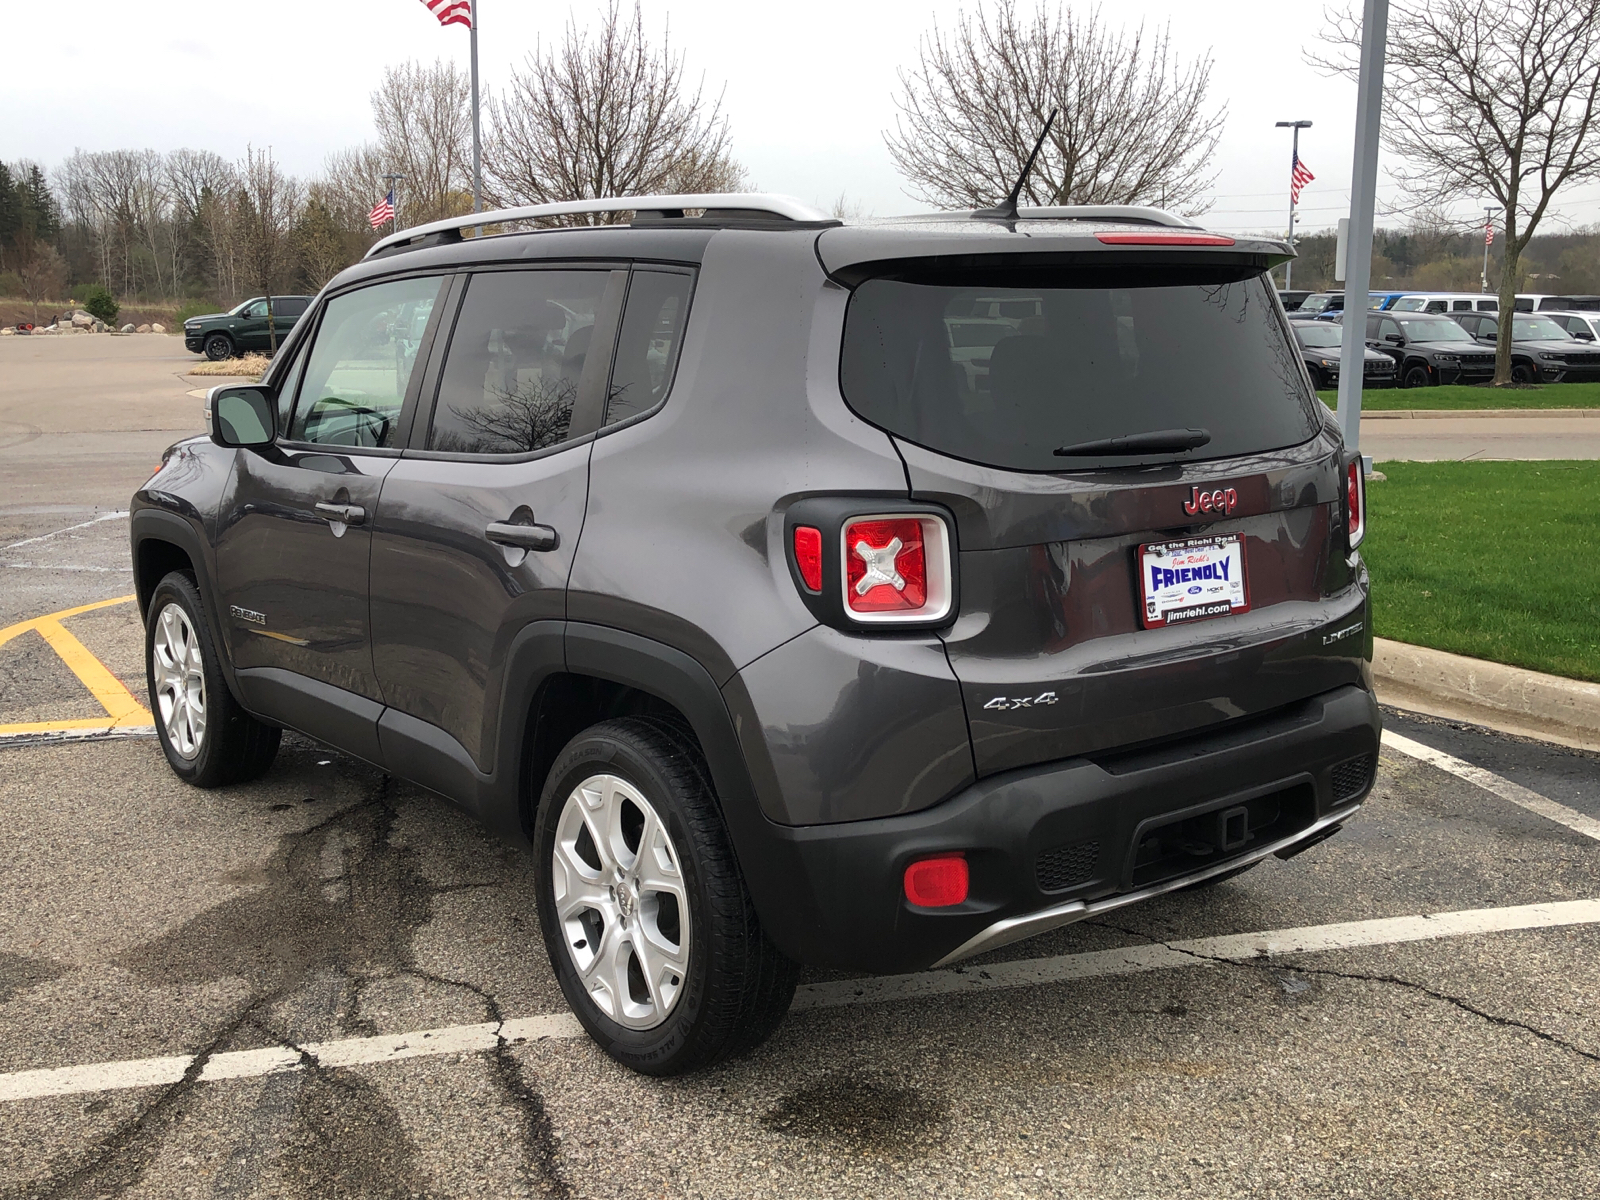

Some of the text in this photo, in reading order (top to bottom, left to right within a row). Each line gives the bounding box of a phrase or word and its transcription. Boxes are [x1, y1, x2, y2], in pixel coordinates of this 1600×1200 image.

[1181, 486, 1238, 516] Jeep
[1168, 541, 1185, 549] the
[1187, 538, 1212, 547] Riehl
[1214, 535, 1237, 543] Deal
[1172, 554, 1210, 569] Jim Riehl's
[1150, 555, 1230, 592] FRIENDLY
[1166, 603, 1230, 624] jimriehl.com
[983, 691, 1059, 711] 4x4
